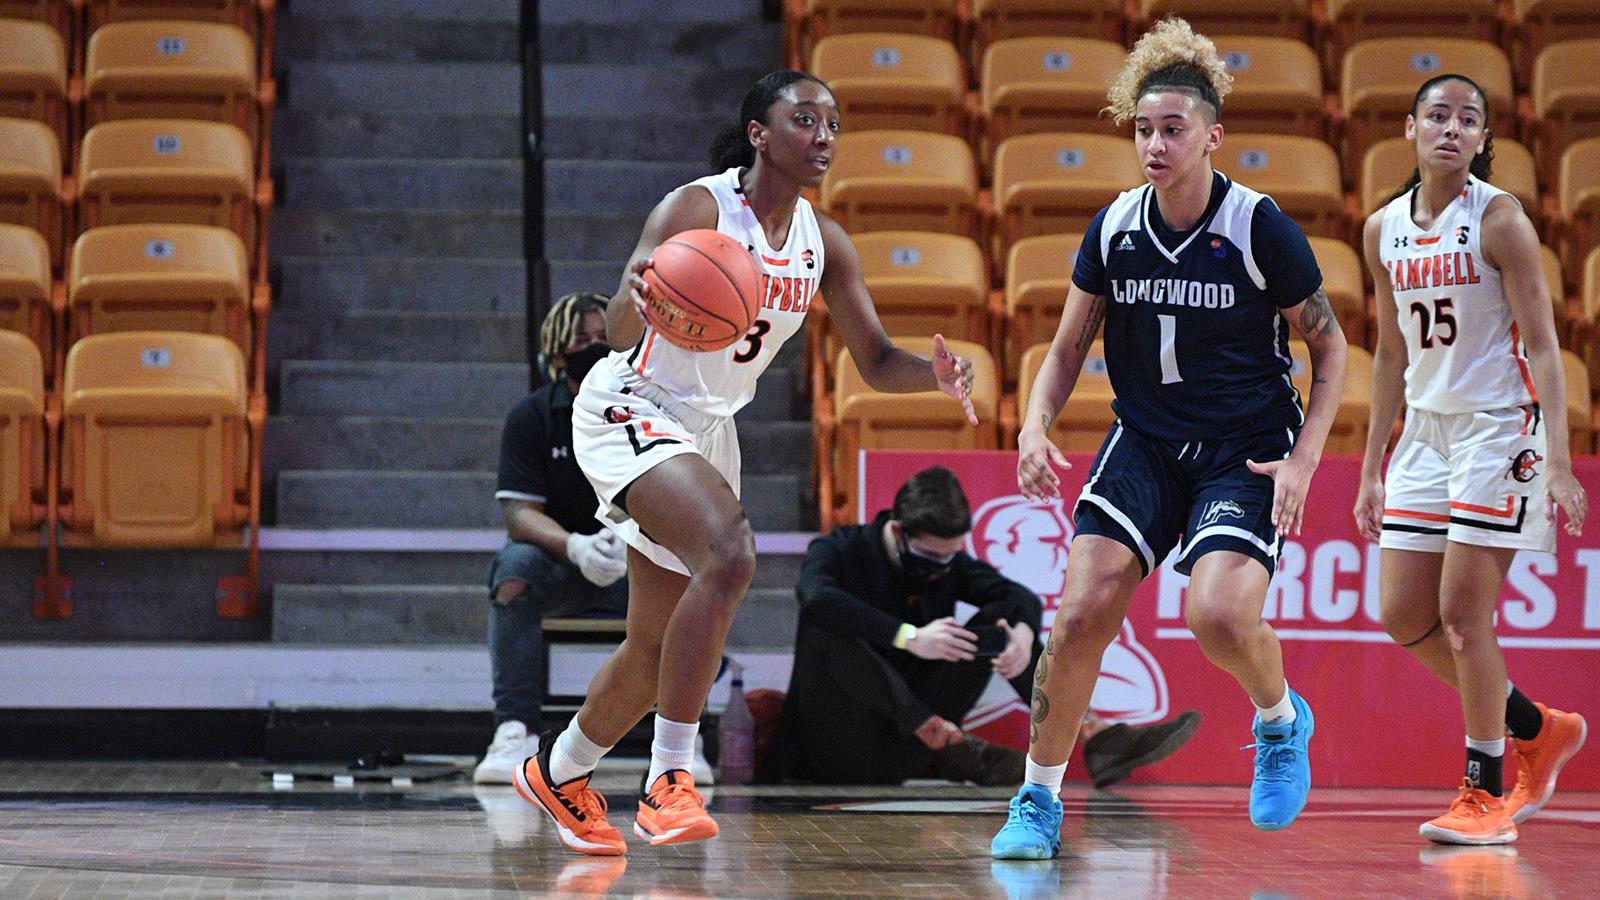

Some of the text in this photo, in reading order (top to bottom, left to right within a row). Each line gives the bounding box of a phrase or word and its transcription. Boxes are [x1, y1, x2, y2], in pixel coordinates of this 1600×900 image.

[1111, 279, 1235, 309] LONGWOOD
[732, 319, 772, 364] 3
[1410, 297, 1458, 349] 25
[1157, 314, 1184, 385] 1
